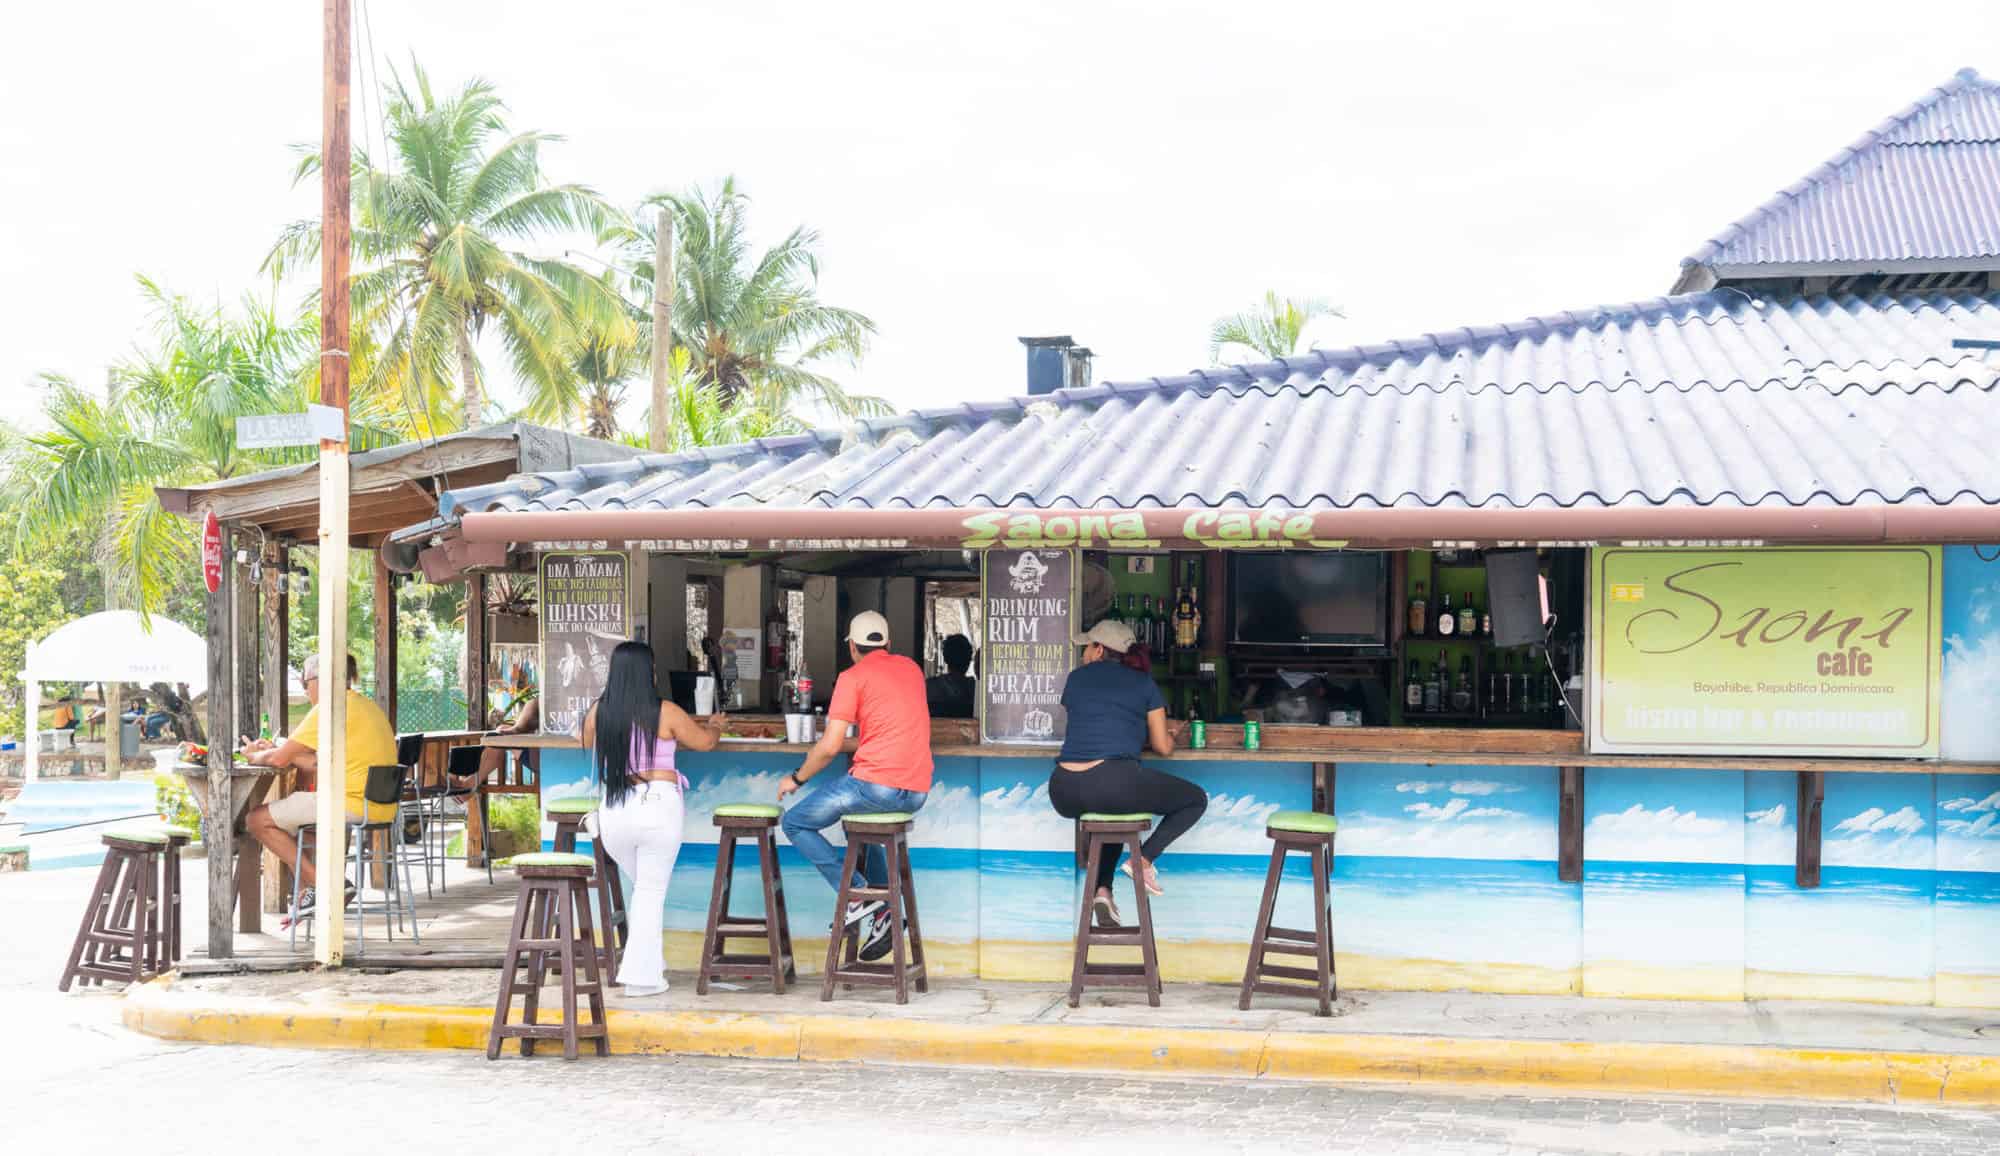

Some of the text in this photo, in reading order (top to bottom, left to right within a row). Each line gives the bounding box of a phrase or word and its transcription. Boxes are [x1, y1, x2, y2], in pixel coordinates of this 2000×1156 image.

[961, 511, 1158, 547] Saona
[575, 562, 621, 577] BANANA
[548, 603, 621, 621] WHISKY
[990, 598, 1067, 616] DRINKING
[1626, 562, 1913, 654] Saona
[988, 617, 1040, 642] RUM
[992, 644, 1030, 658] BEFORE
[988, 673, 1055, 693] PIRATE
[1820, 682, 1894, 694] Dominicana
